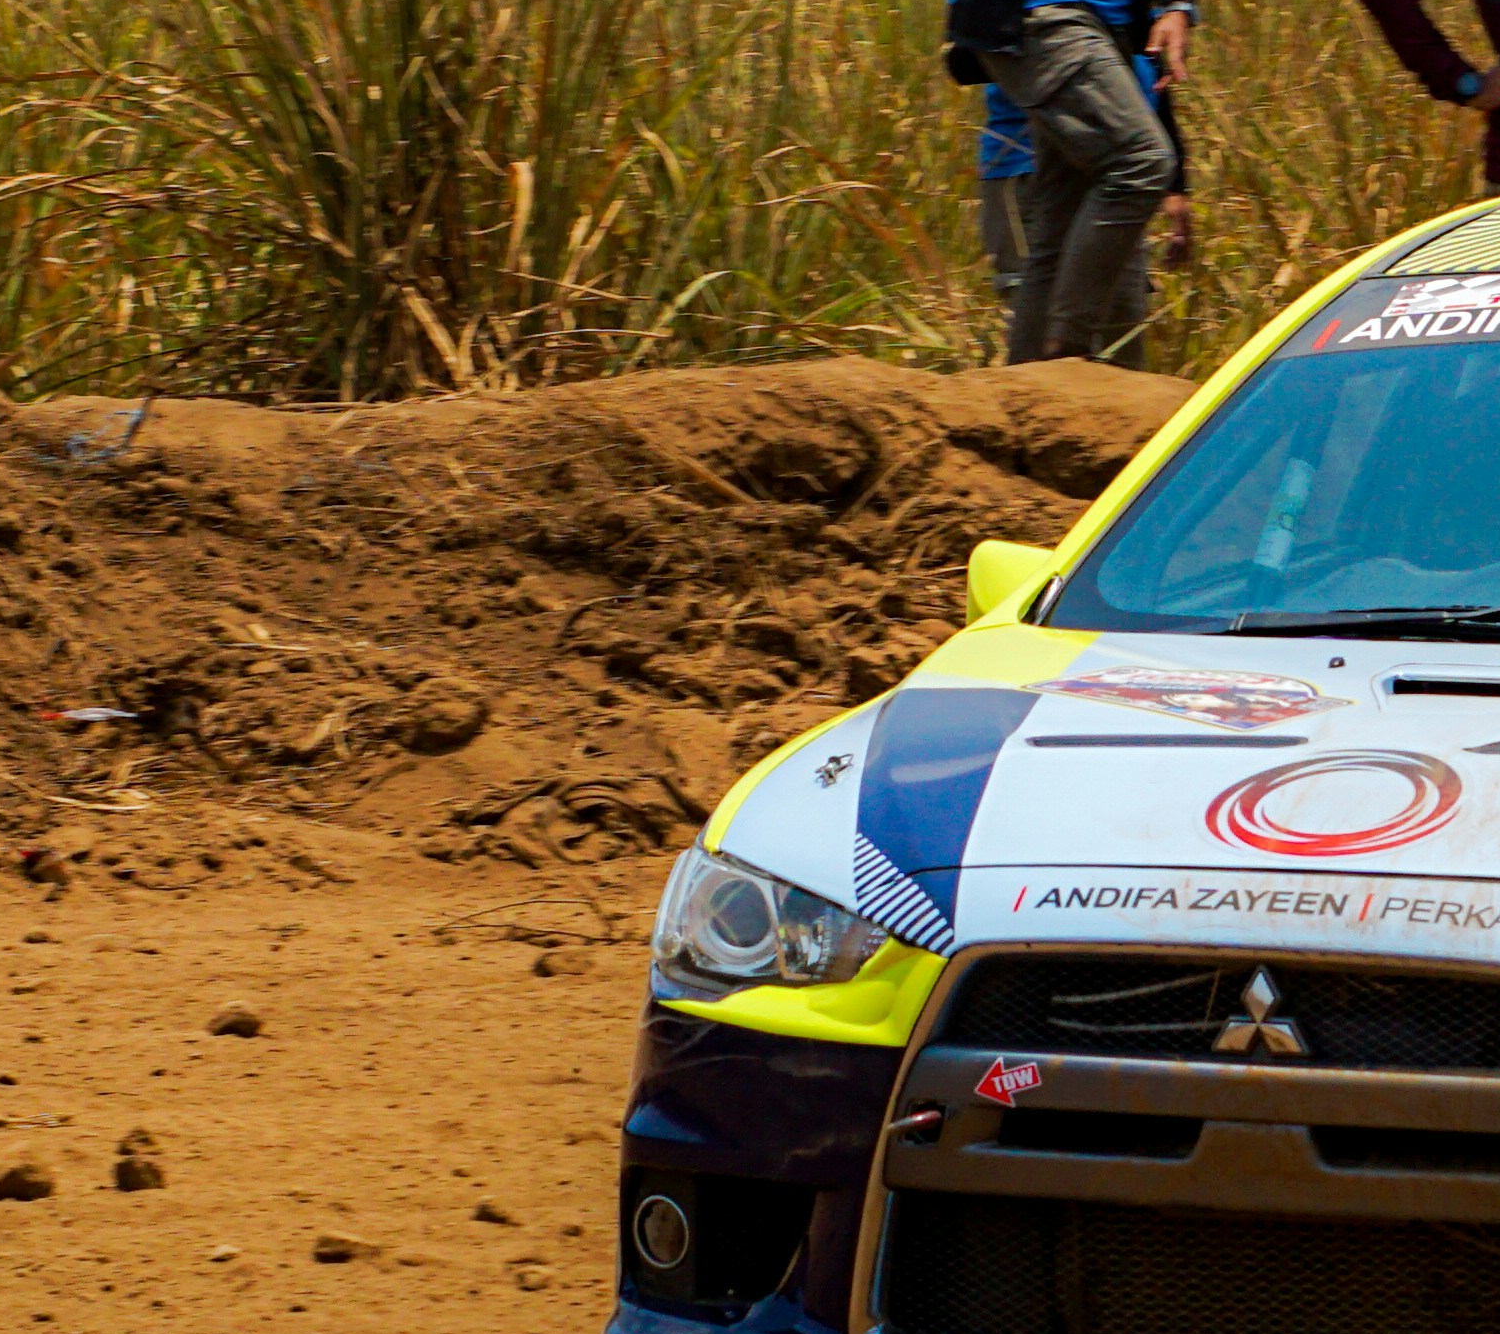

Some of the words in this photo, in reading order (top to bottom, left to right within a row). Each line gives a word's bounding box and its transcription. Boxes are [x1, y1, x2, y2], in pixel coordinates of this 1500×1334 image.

[1035, 887, 1179, 910] ANDIFA
[1188, 888, 1349, 917] ZAYEEN
[991, 1067, 1033, 1094] TOW
